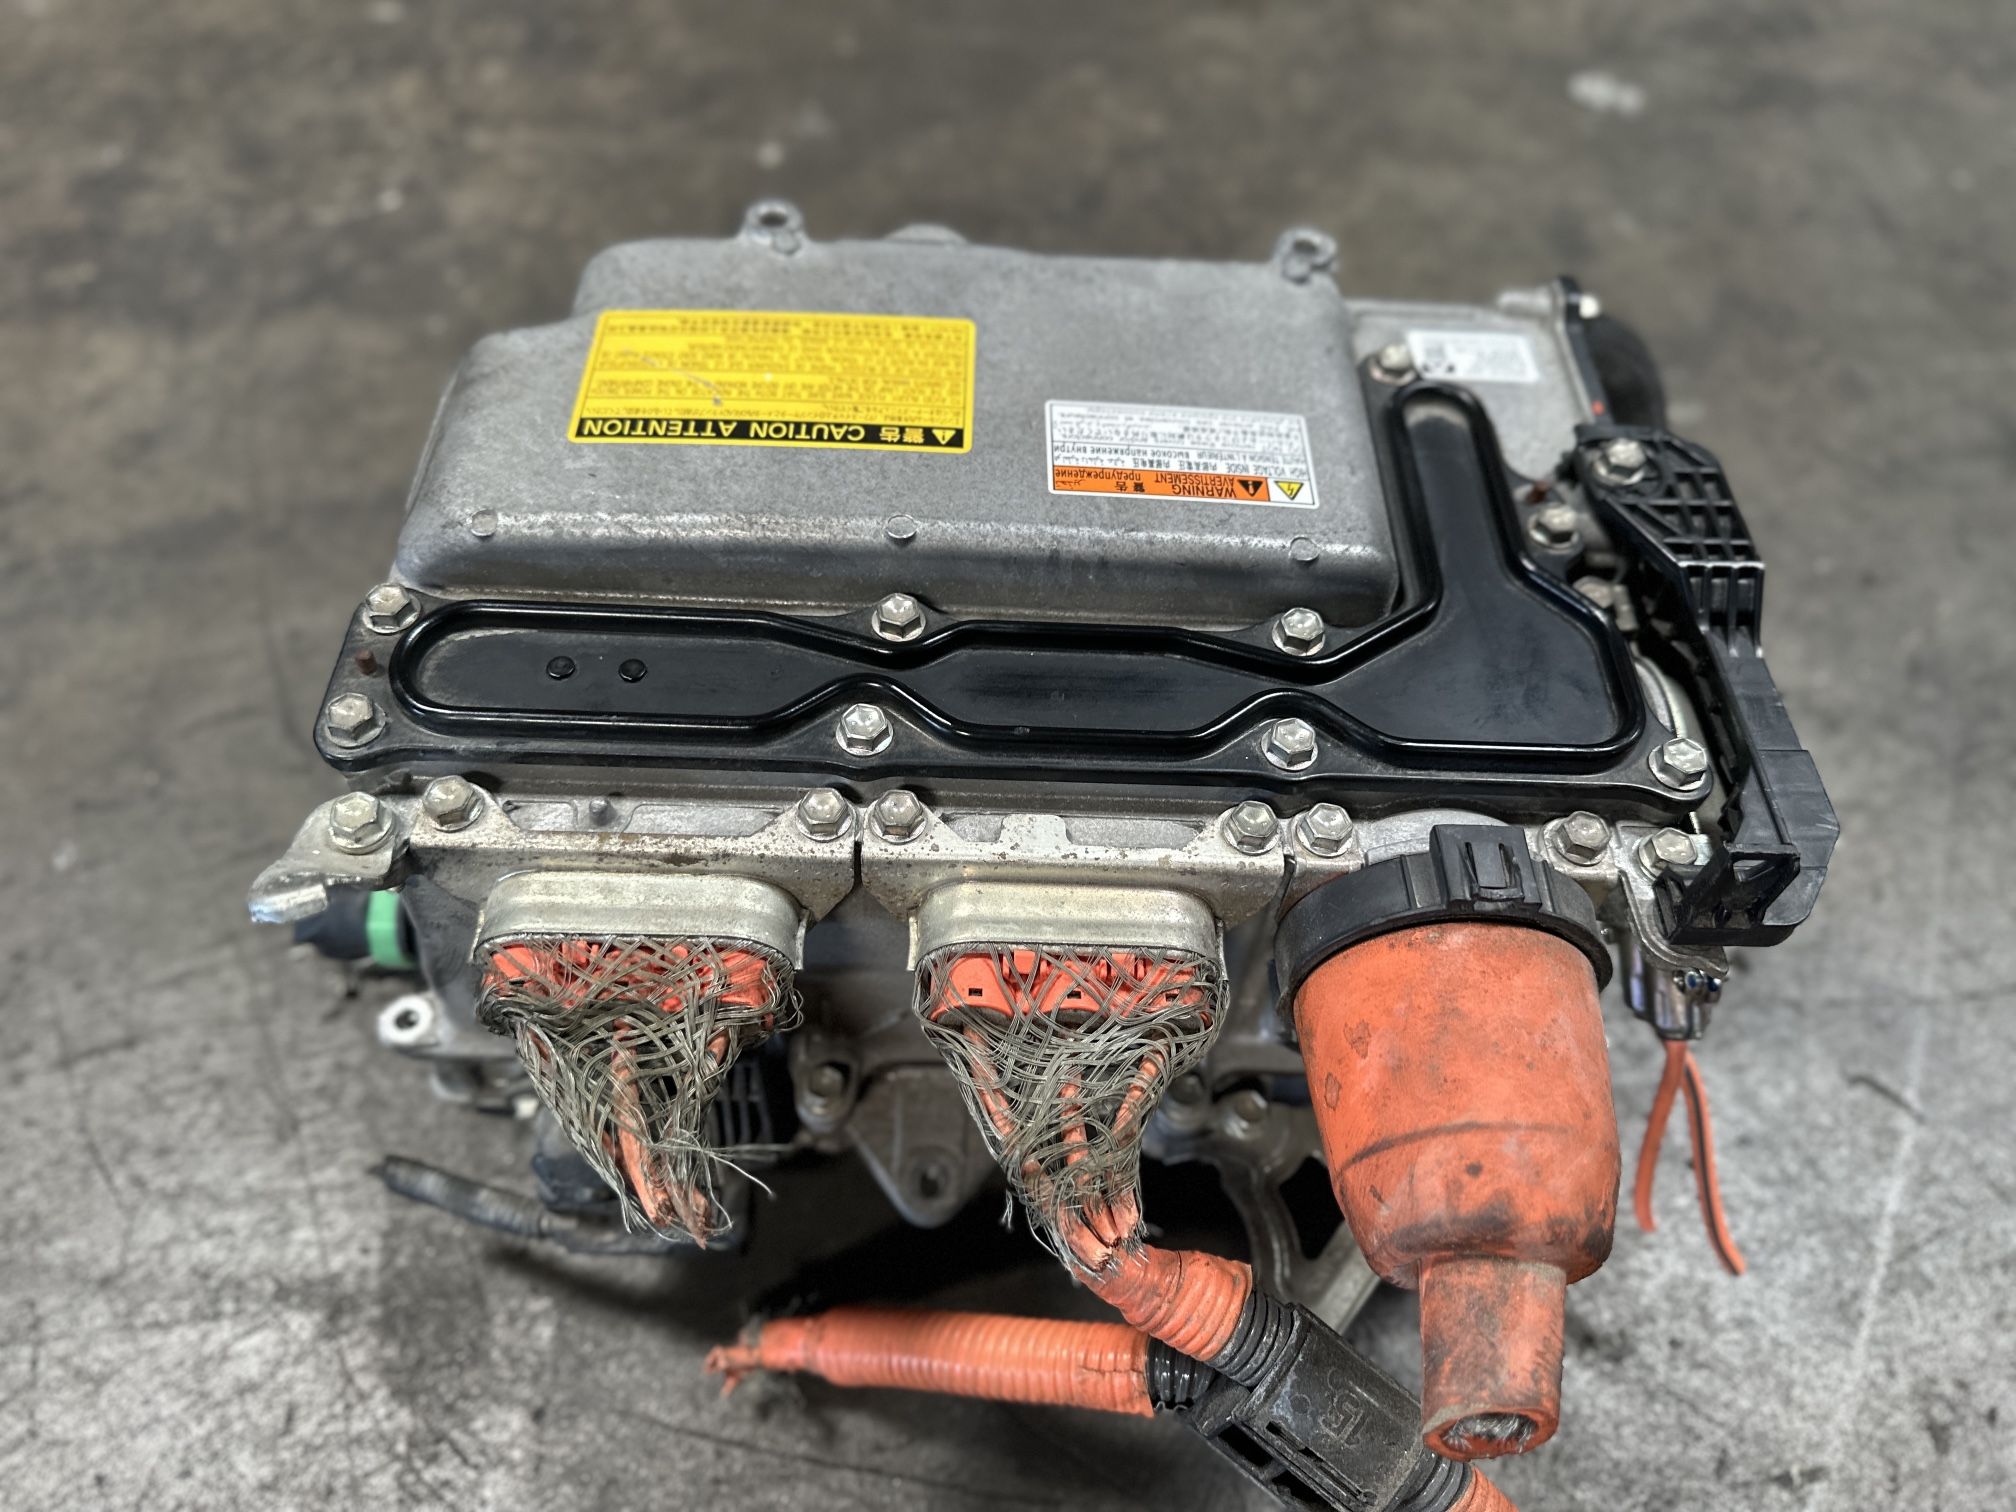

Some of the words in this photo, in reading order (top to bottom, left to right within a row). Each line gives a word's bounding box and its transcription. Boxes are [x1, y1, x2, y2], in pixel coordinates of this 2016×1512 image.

[582, 418, 738, 438] ATTENTION
[748, 422, 866, 441] CAUTION
[879, 427, 925, 444] 警告
[1225, 463, 1250, 474] INSIDE
[1253, 465, 1286, 475] VOLTAGE
[1055, 469, 1142, 482] предупреждение
[1154, 473, 1236, 486] AVERTISSEMENT
[1171, 484, 1237, 497] WARNING
